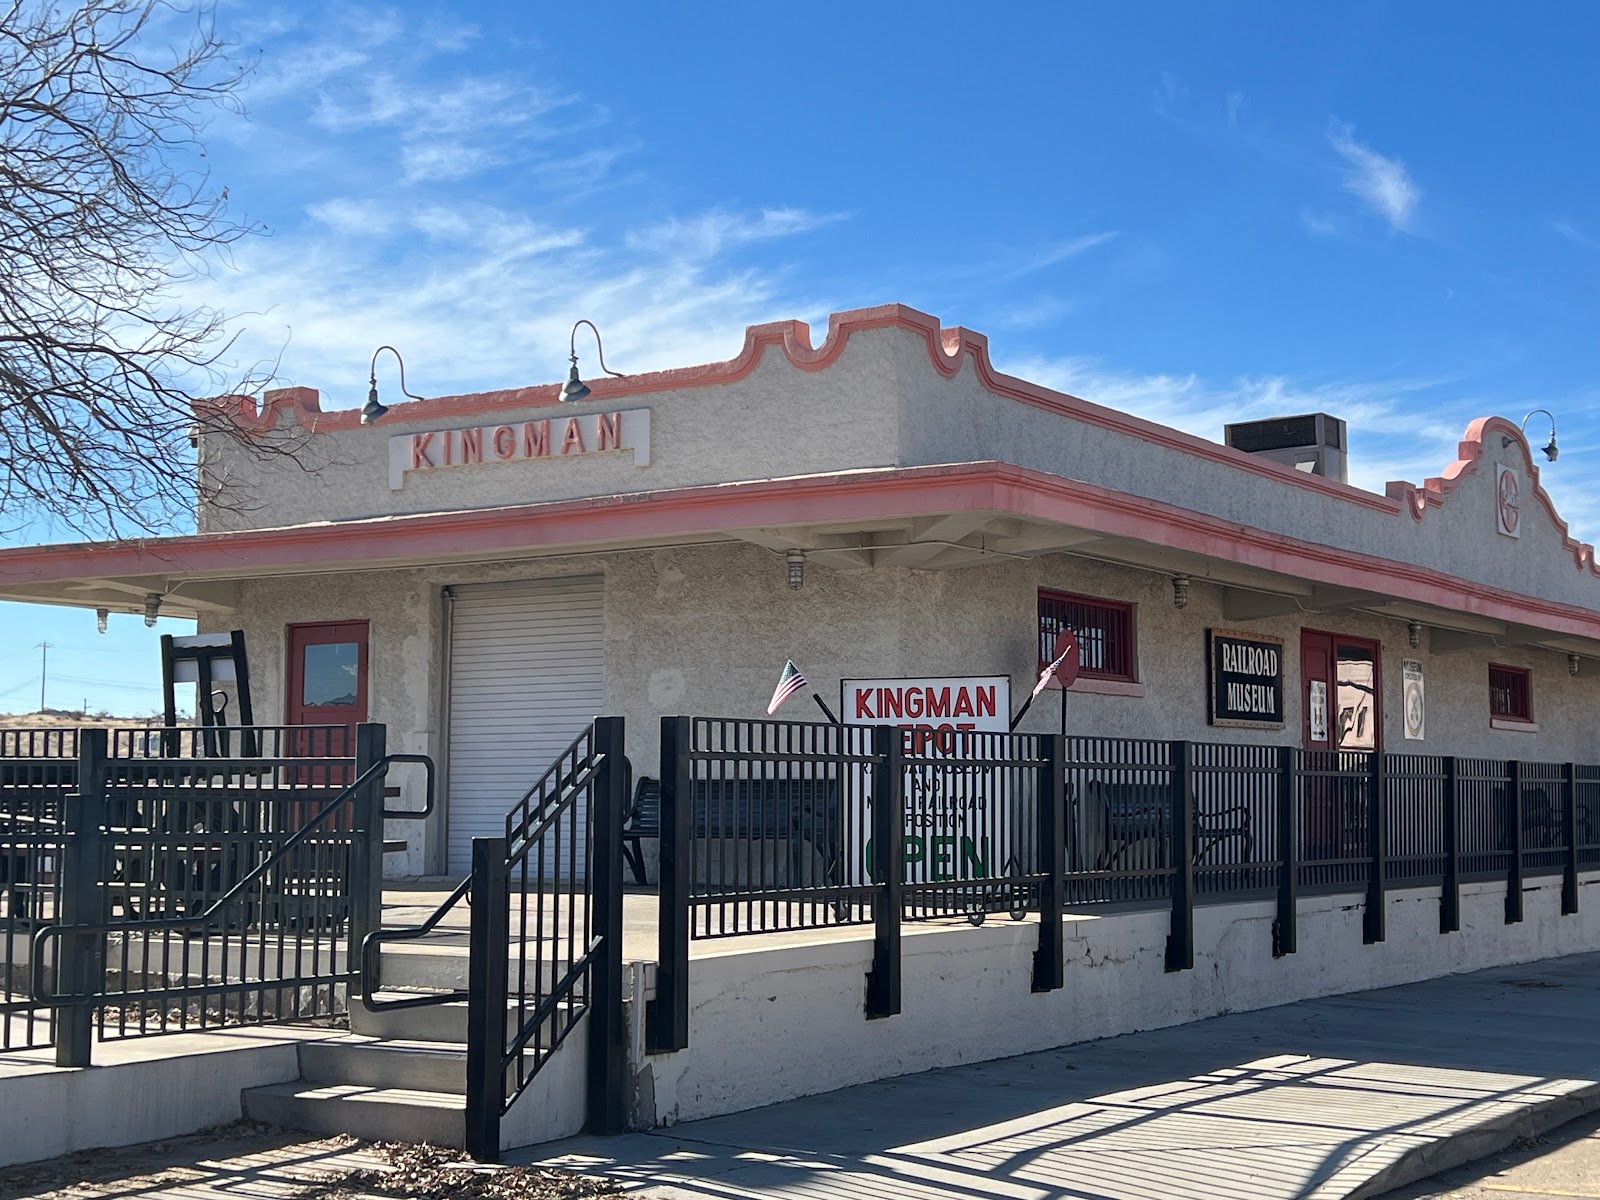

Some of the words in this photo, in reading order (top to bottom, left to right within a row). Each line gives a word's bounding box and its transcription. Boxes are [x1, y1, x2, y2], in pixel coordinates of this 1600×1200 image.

[412, 412, 621, 468] KINGMAN
[1222, 642, 1278, 677] RAILROAD
[855, 685, 996, 719] KINGMAN
[1227, 681, 1276, 714] MUSEUM
[876, 723, 976, 756] EPOT
[865, 835, 990, 882] PEN
